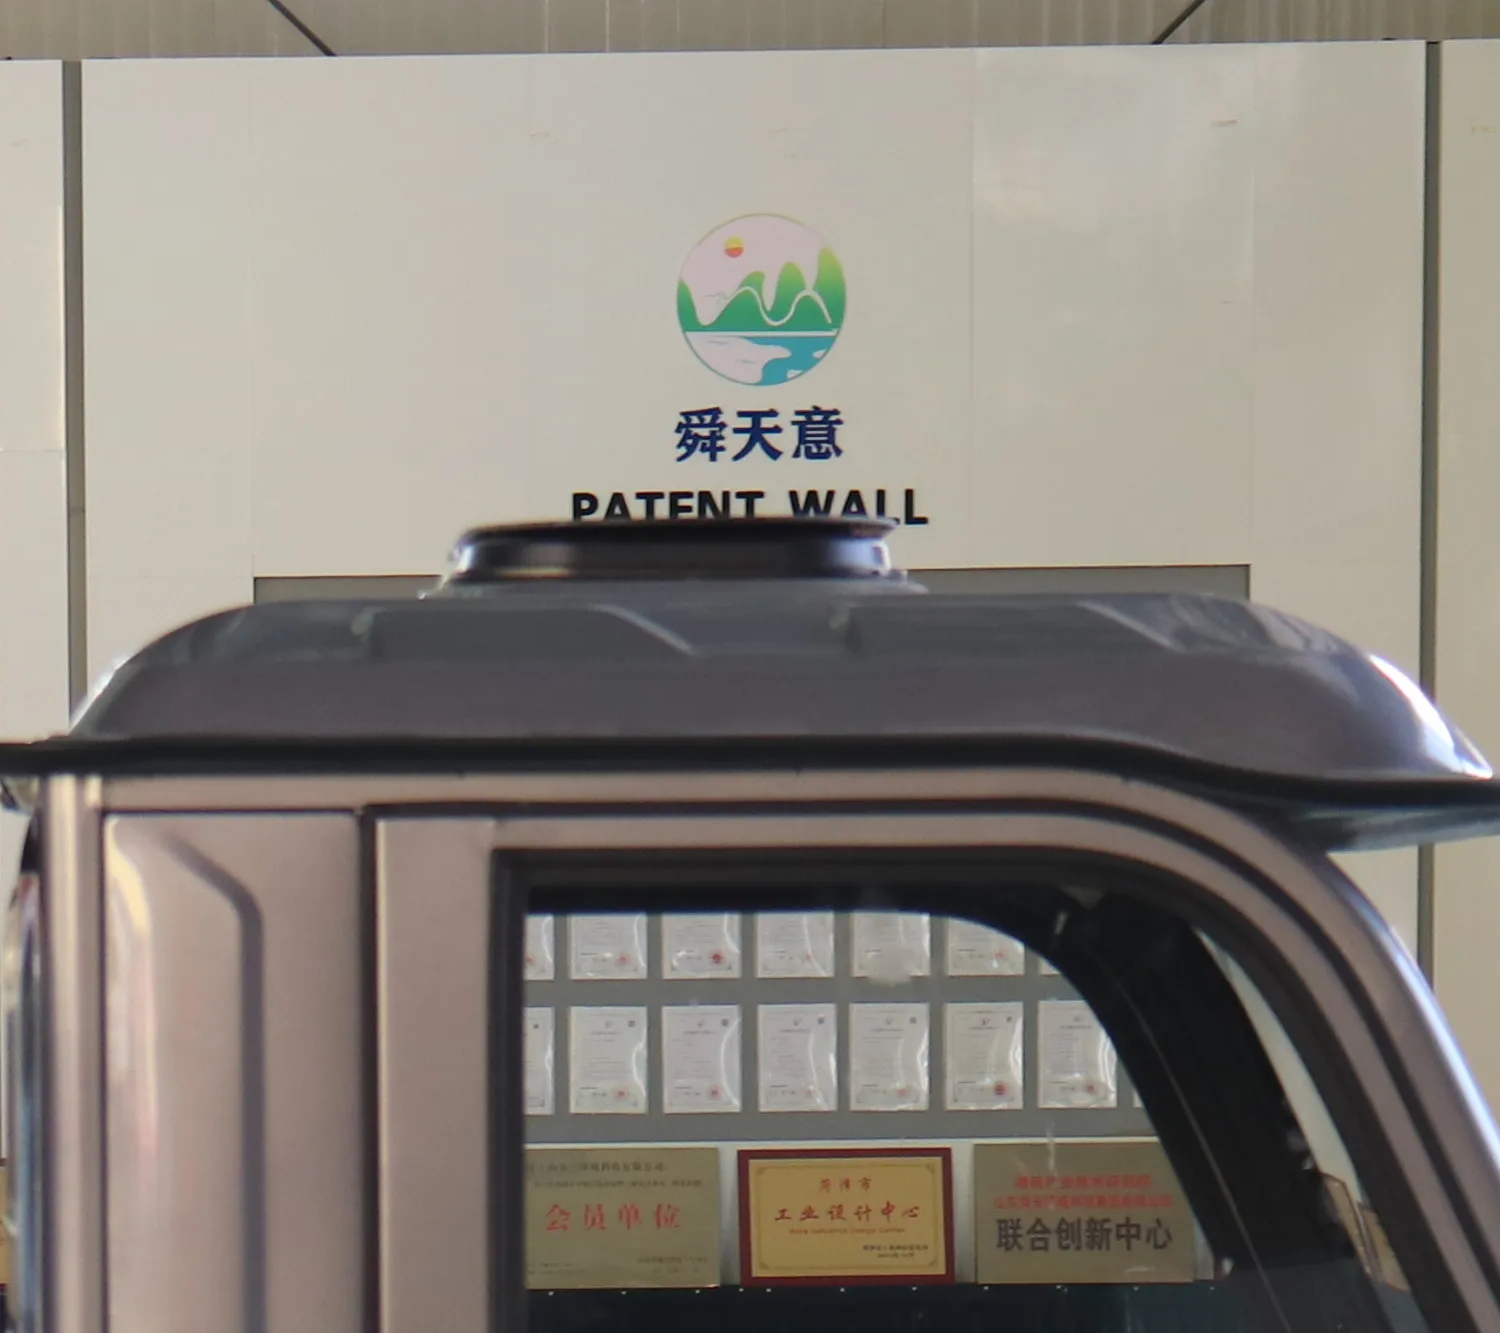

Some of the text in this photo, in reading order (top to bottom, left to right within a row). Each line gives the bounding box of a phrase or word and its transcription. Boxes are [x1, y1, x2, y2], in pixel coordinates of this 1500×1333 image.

[674, 406, 844, 462] 舜天意
[572, 489, 929, 525] PATENT WALL
[545, 1203, 681, 1231] 会员单位
[774, 1201, 920, 1223] 工业设计中心
[996, 1217, 1173, 1252] 联合创新中心
